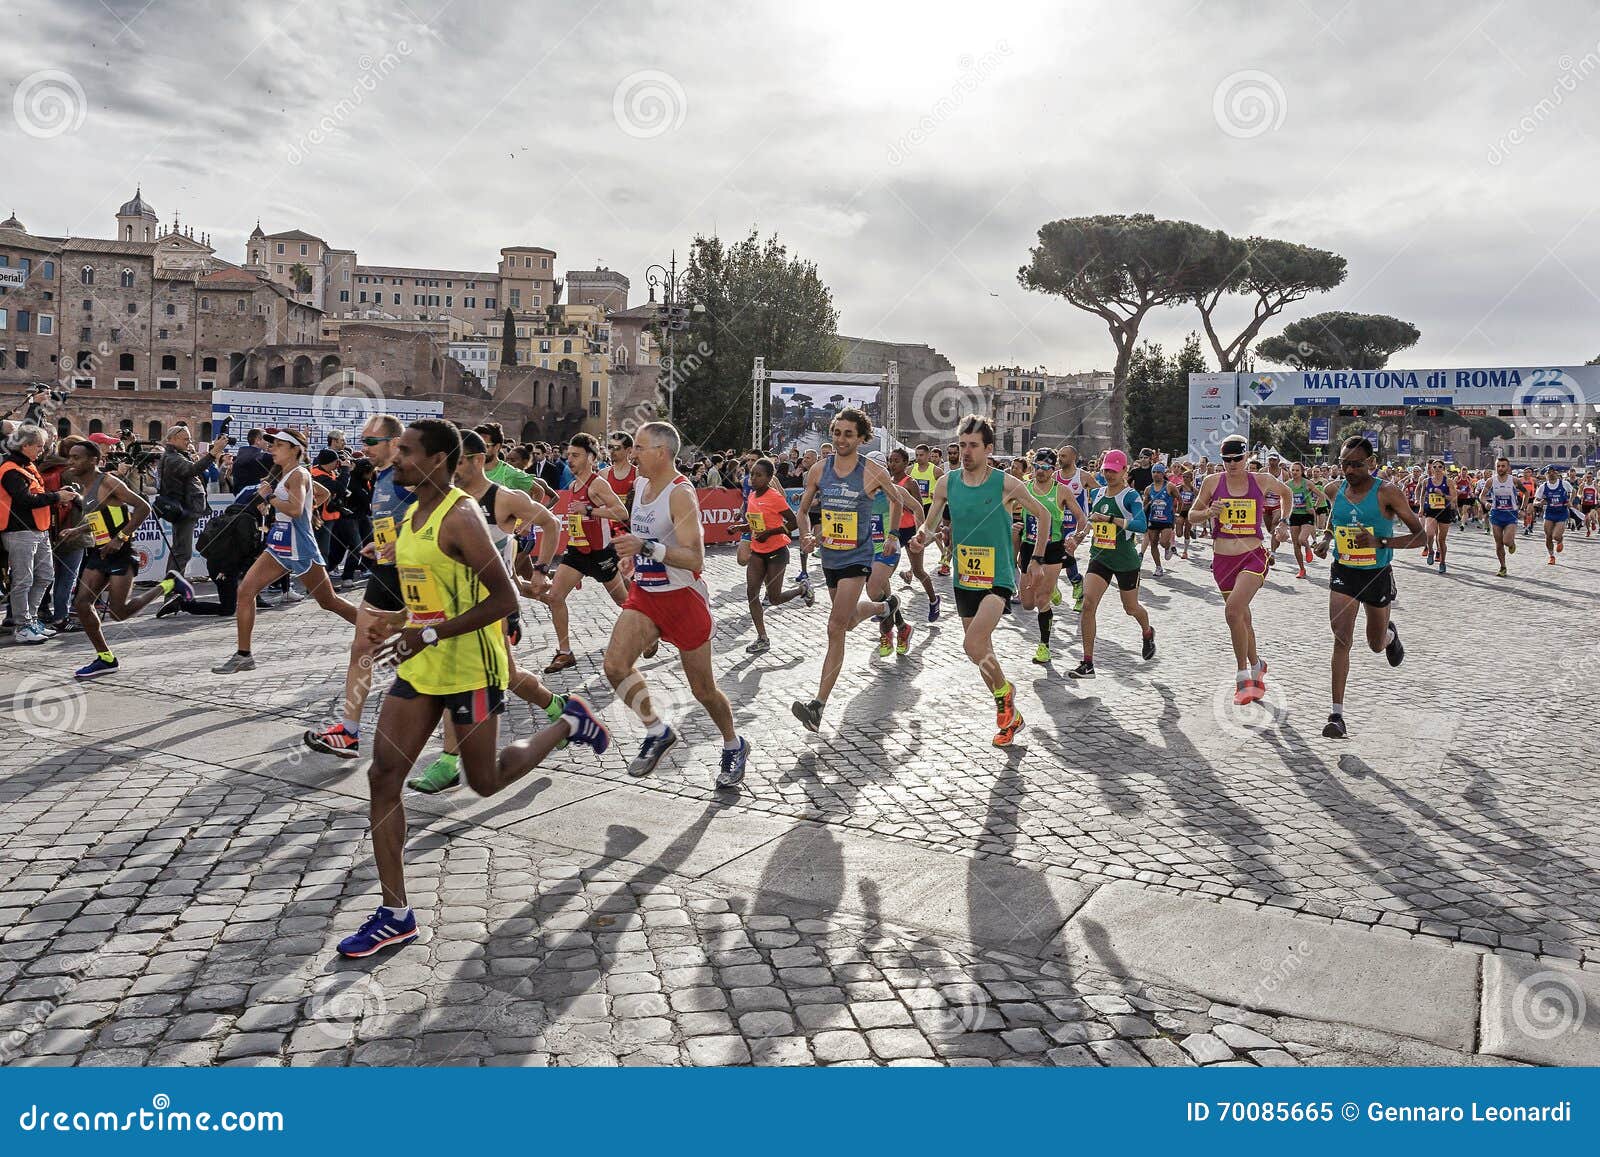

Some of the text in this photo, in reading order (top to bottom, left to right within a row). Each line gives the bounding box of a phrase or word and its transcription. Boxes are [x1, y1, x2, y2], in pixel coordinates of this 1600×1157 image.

[1304, 369, 1563, 389] MARATONA di ROMA 22
[1380, 409, 1403, 417] TIMEX
[1228, 510, 1246, 519] F 13
[832, 522, 844, 534] 16
[1096, 525, 1108, 535] F 9
[967, 558, 981, 570] 42
